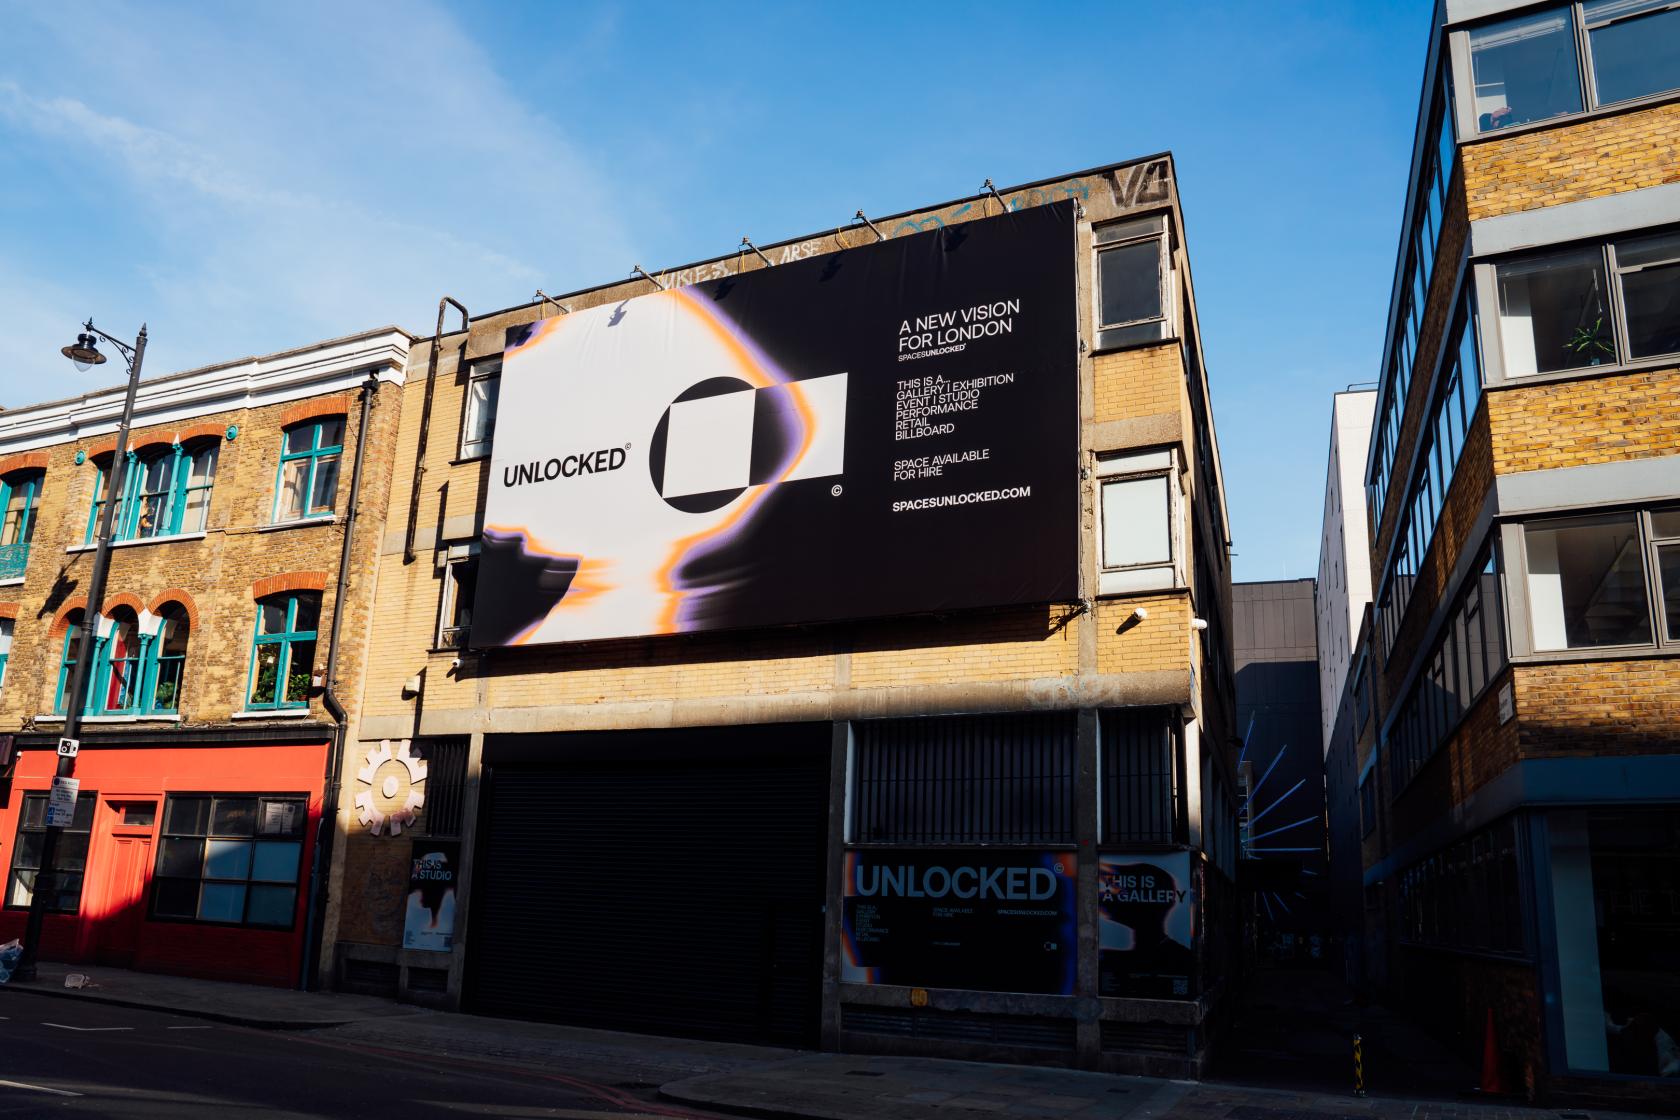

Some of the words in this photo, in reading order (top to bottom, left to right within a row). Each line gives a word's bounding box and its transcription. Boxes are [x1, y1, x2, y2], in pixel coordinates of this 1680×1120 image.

[899, 320, 911, 335] A
[916, 310, 956, 332] NEW
[961, 298, 1020, 323] VISION
[899, 333, 933, 352] FOR
[937, 317, 1012, 346] LONDON
[896, 383, 945, 401] GALLERY
[952, 373, 1014, 392] EXHIBITION
[897, 378, 921, 391] THIS
[923, 376, 933, 386] IS
[896, 396, 931, 411] EVENT
[938, 389, 980, 404] STUDIO
[896, 399, 978, 421] PERFORMANCE
[895, 417, 930, 430] RETAIL
[895, 423, 955, 440] BILLBOARD
[894, 457, 930, 471] SPACE
[931, 449, 990, 466] AVAILABLE
[894, 470, 916, 481] FOR
[918, 466, 943, 478] HIRE
[892, 486, 1031, 512] SPACESUNLOCKED.COM
[419, 870, 452, 880] STUDIO
[1141, 875, 1155, 888] IS
[1117, 889, 1186, 903] GALLERY
